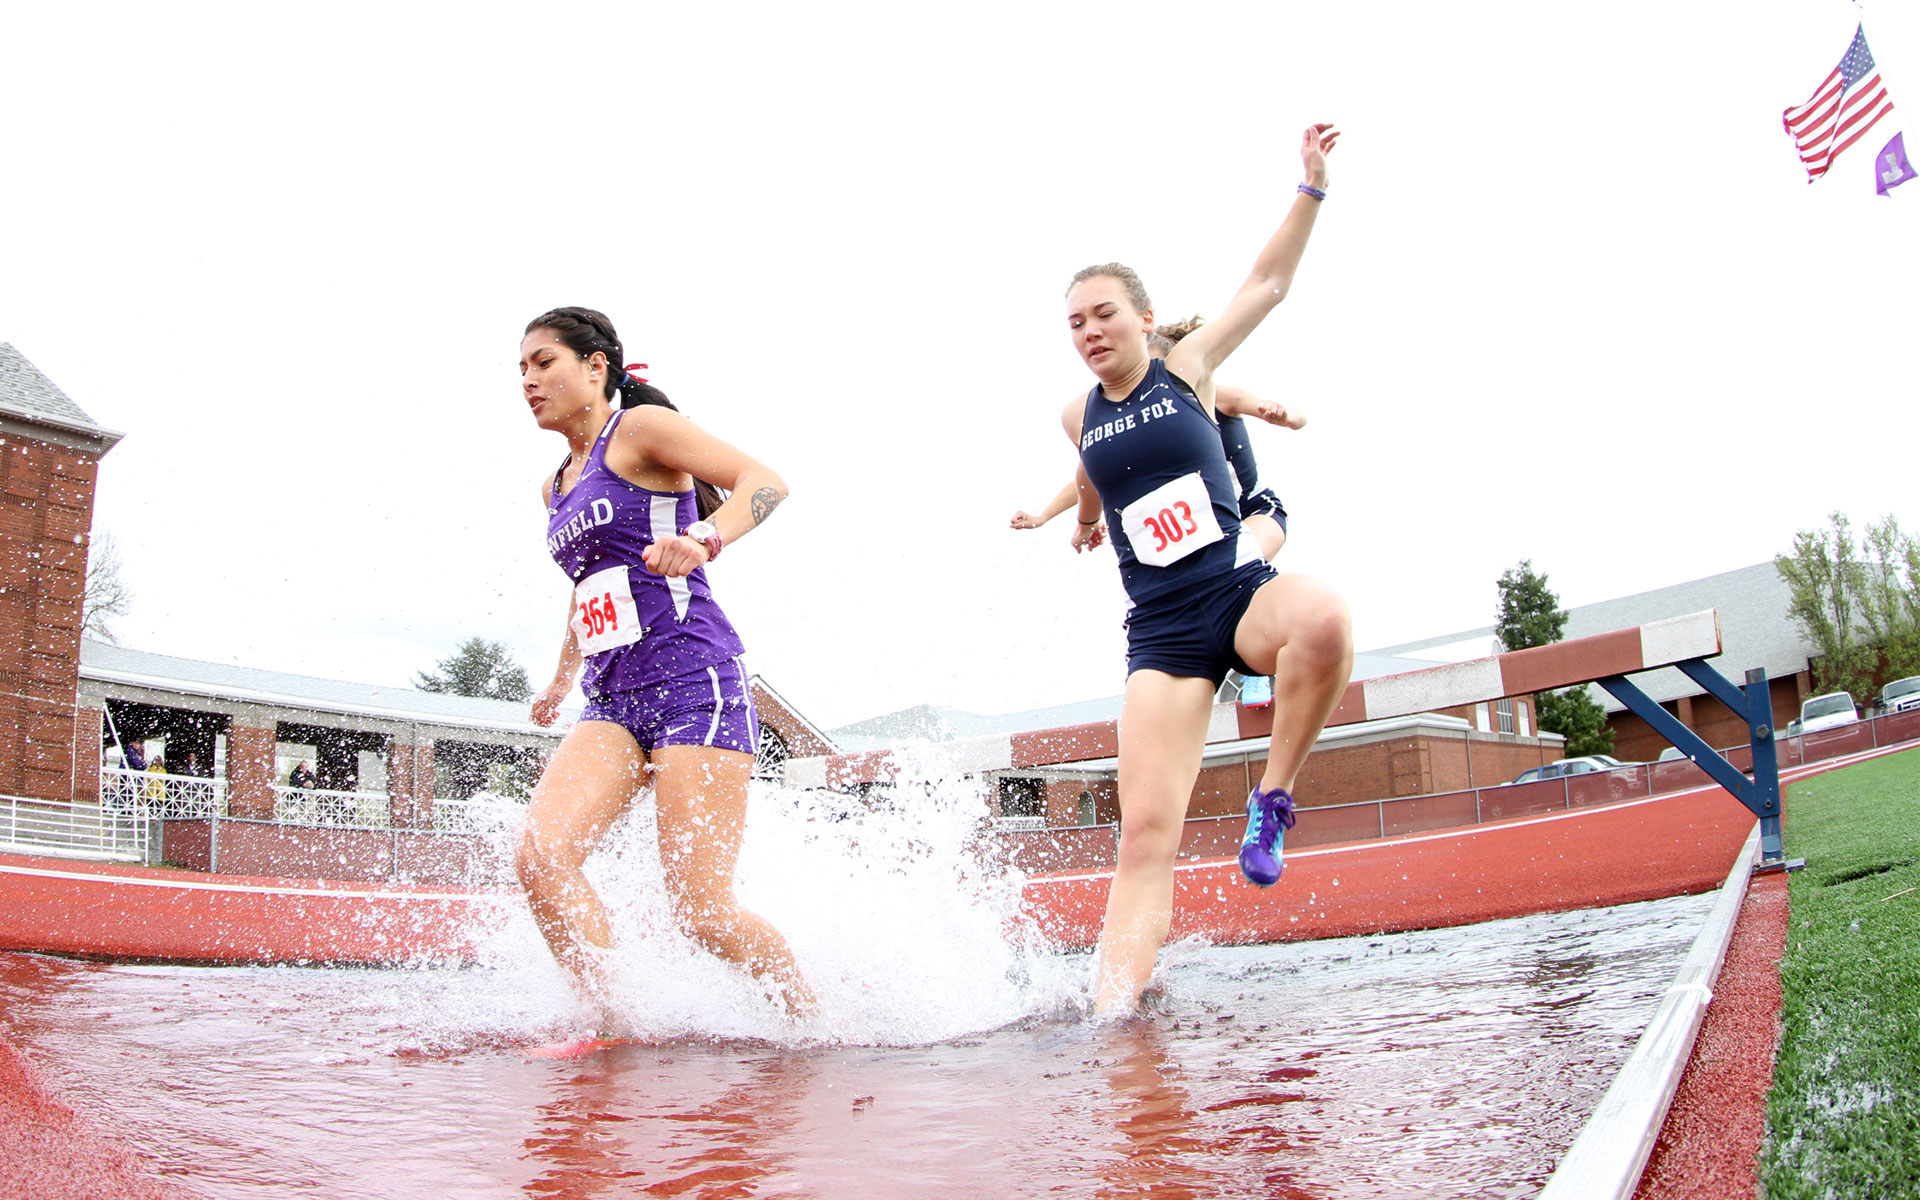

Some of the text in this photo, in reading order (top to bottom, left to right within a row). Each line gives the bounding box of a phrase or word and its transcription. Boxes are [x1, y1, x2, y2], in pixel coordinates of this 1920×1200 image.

[1082, 399, 1178, 451] GEORGE FOX
[1143, 500, 1198, 553] 303
[579, 592, 618, 639] 364
